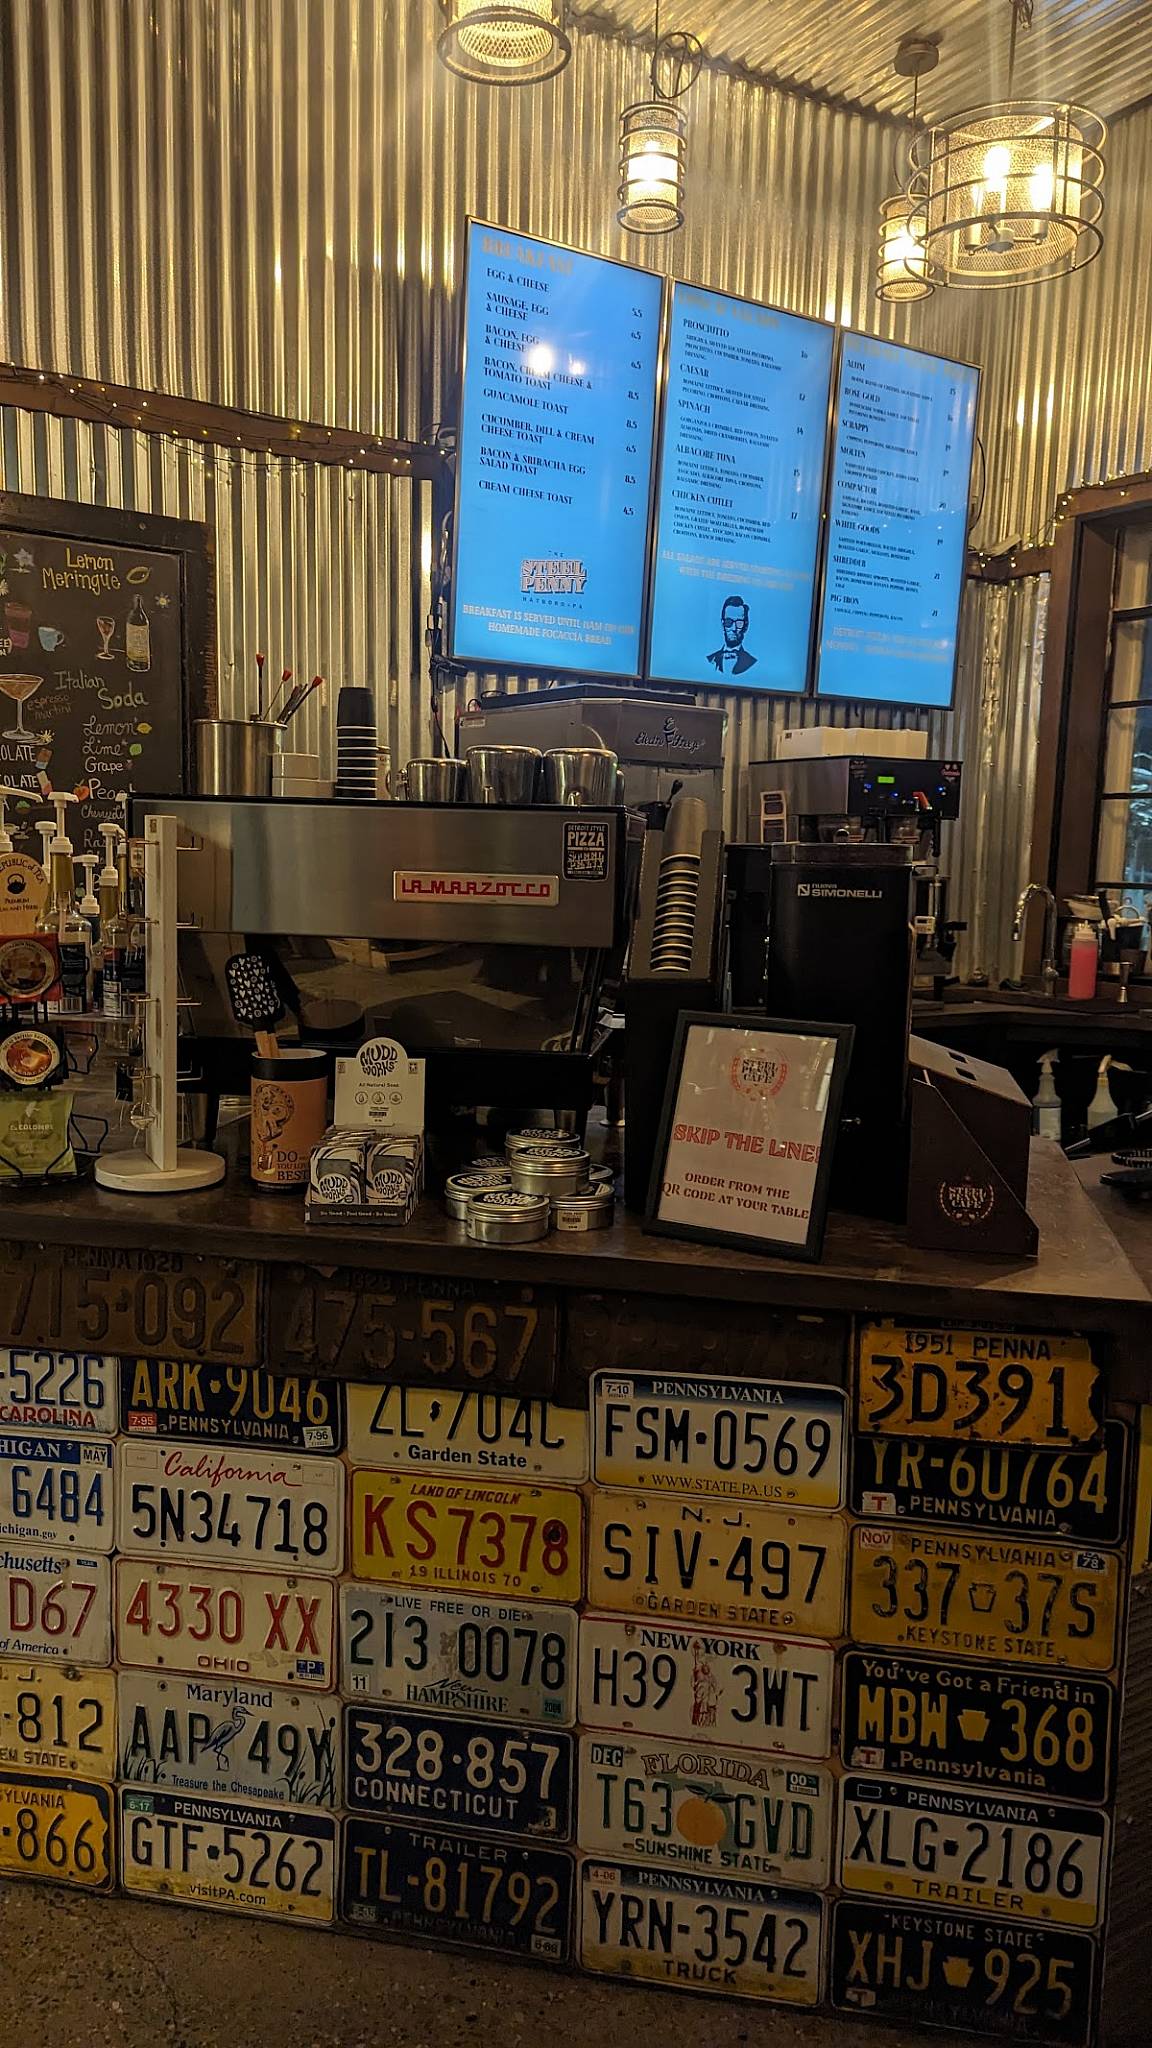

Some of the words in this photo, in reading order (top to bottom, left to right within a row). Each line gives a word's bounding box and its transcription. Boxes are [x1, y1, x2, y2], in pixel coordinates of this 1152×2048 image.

[486, 267, 505, 280] EGG
[508, 274, 514, 283] &
[517, 274, 550, 292] CHEESE
[531, 302, 549, 316] EGG
[484, 367, 523, 385] TOMATO
[524, 375, 552, 390] TOAST
[483, 388, 539, 409] GUACAMOLE
[542, 401, 568, 415] TOAST
[678, 399, 711, 415] SPINACH
[481, 424, 515, 440] CHEESE
[517, 431, 543, 444] TOAST
[535, 423, 555, 437] DILL
[565, 429, 595, 445] CREAM
[480, 446, 512, 461] BACON
[568, 464, 586, 475] EGG
[480, 457, 509, 471] SALAD
[511, 464, 538, 476] TOAST
[479, 480, 510, 494] CREAM
[513, 487, 543, 500] CHEESE
[547, 493, 573, 505] TOAST
[66, 547, 115, 571] Lemon
[42, 567, 121, 596] Meringue
[53, 669, 105, 690] Italian
[97, 681, 150, 710] Soda
[82, 715, 138, 736] Lemon
[82, 736, 124, 757] Lime
[85, 756, 124, 775] Grape
[567, 832, 604, 847] PIZZA
[812, 889, 883, 898] SIMONELLI
[359, 1044, 398, 1067] MUDD
[362, 1060, 396, 1077] WORKS
[673, 1123, 720, 1146] SKIP
[724, 1131, 764, 1153] THE
[277, 1151, 298, 1162] DO
[685, 1172, 725, 1188] ORDER
[728, 1180, 763, 1195] FROM
[766, 1187, 790, 1199] THE
[662, 1182, 681, 1196] QR
[683, 1188, 715, 1202] CODE
[718, 1195, 734, 1205] AT
[736, 1198, 768, 1212] YOUR
[771, 1204, 809, 1219] TABLE
[284, 1287, 540, 1383] 475-567
[904, 1331, 953, 1355] 1951
[973, 1336, 1050, 1361] PENNA
[605, 1383, 630, 1396] 7-10
[652, 1381, 784, 1404] PENNSYLVANIA
[868, 1354, 1070, 1438] 3D391
[164, 1451, 303, 1488] California
[408, 1445, 471, 1464] Garden
[478, 1451, 527, 1468] State
[11, 1464, 104, 1526] 6484
[410, 1484, 443, 1497] LAND
[446, 1488, 463, 1499] OF
[465, 1489, 522, 1505] LINCOLN
[650, 1474, 782, 1498] WWW.STATE.PA.US
[131, 1483, 328, 1556] 5N34718
[871, 1496, 887, 1512] T
[910, 1495, 1057, 1527] PENNSYLVANIA
[603, 1523, 827, 1604] SIV-497
[861, 1532, 891, 1545] NOV
[911, 1537, 1056, 1568] PENNSYLVANIA
[1082, 1557, 1099, 1570] 78
[409, 1564, 428, 1578] 19
[434, 1568, 496, 1584] ILLINOIS
[503, 1575, 521, 1587] 70
[125, 1579, 244, 1644] 4330
[264, 1592, 321, 1655] XX
[394, 1599, 421, 1610] LIVE
[430, 1600, 464, 1615] FREE
[471, 1605, 491, 1617] OR
[499, 1607, 521, 1621] DIE
[647, 1594, 720, 1619] GARDEN
[727, 1605, 779, 1626] STATE
[350, 1609, 428, 1671] 213
[458, 1622, 566, 1690] 0078
[640, 1629, 692, 1652] NEW
[701, 1637, 760, 1662] YORK
[906, 1624, 996, 1653] KEYSTONE
[1004, 1637, 1055, 1658] STATE
[198, 1655, 249, 1672] OHIO
[352, 1675, 367, 1690] 11
[425, 1678, 489, 1693] New
[592, 1647, 677, 1711] H39
[730, 1663, 819, 1732] 3WT
[862, 1658, 930, 1684] You've
[936, 1669, 973, 1691] Got
[979, 1679, 992, 1692] a
[997, 1676, 1069, 1701] Friend
[1075, 1685, 1095, 1705] in
[187, 1683, 273, 1708] Maryland
[406, 1684, 509, 1713] HAMPSHIRE
[857, 1684, 948, 1750] MBW
[1000, 1698, 1094, 1772] 368
[592, 1749, 623, 1767] DEC
[641, 1752, 770, 1791] FLORIDA
[790, 1774, 807, 1786] 00
[171, 1774, 208, 1791] Treasure
[212, 1779, 227, 1791] the
[231, 1782, 285, 1801] Chesapeake
[354, 1776, 518, 1820] CONNECTICUT
[174, 1802, 282, 1829] PENNSYLVANIA
[596, 1773, 673, 1837] T63
[733, 1793, 813, 1860] GVD
[907, 1790, 1039, 1823] PENNSYLVANIA
[409, 1832, 507, 1863] TRAILER
[633, 1837, 712, 1865] SUNSHINE
[720, 1850, 772, 1874] STATE
[189, 1883, 266, 1905] visitPA.com
[911, 1879, 1024, 1911] TRAILER
[592, 1889, 808, 1978] YRN-3542
[890, 1914, 975, 1940] KEYSTONE
[984, 1927, 1034, 1949] STATE
[663, 1959, 737, 1984] TRUCK
